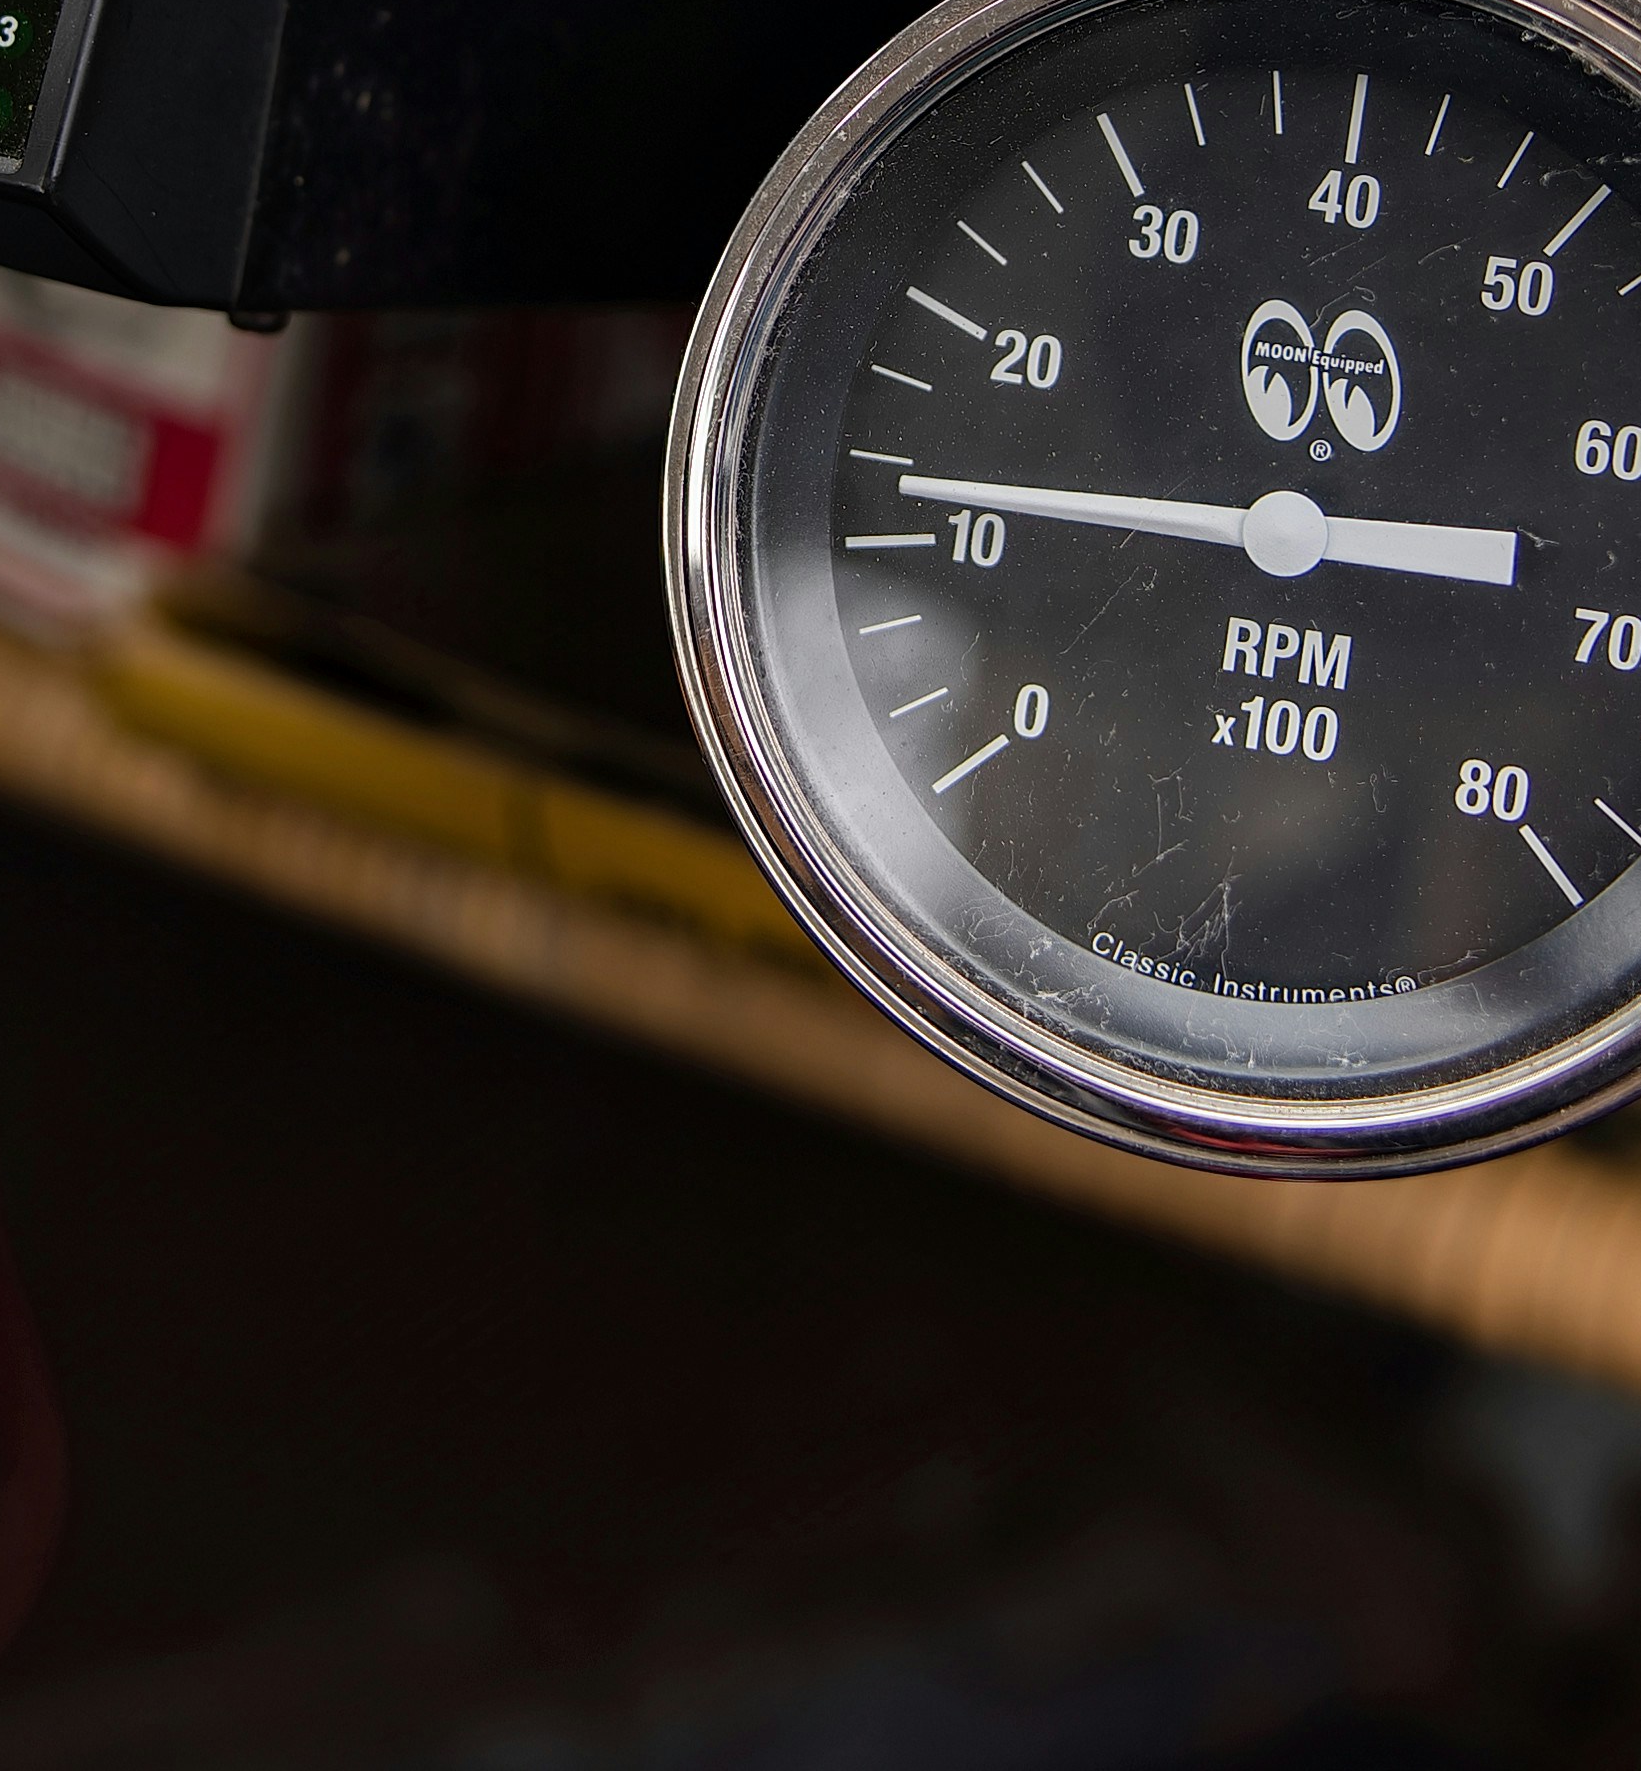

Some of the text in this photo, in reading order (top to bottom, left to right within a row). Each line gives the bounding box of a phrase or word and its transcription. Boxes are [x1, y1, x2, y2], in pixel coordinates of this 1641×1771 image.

[1308, 169, 1381, 230] 40
[1129, 205, 1200, 265] 30
[1480, 255, 1555, 317] 50
[990, 329, 1063, 389] 20
[1255, 341, 1385, 376] MOON Equipped
[948, 509, 1007, 569] 10
[1222, 615, 1353, 691] RPM
[1012, 682, 1051, 740] 0
[1210, 696, 1341, 763] x100
[1454, 757, 1530, 823] 80
[1091, 931, 1197, 989] Classic
